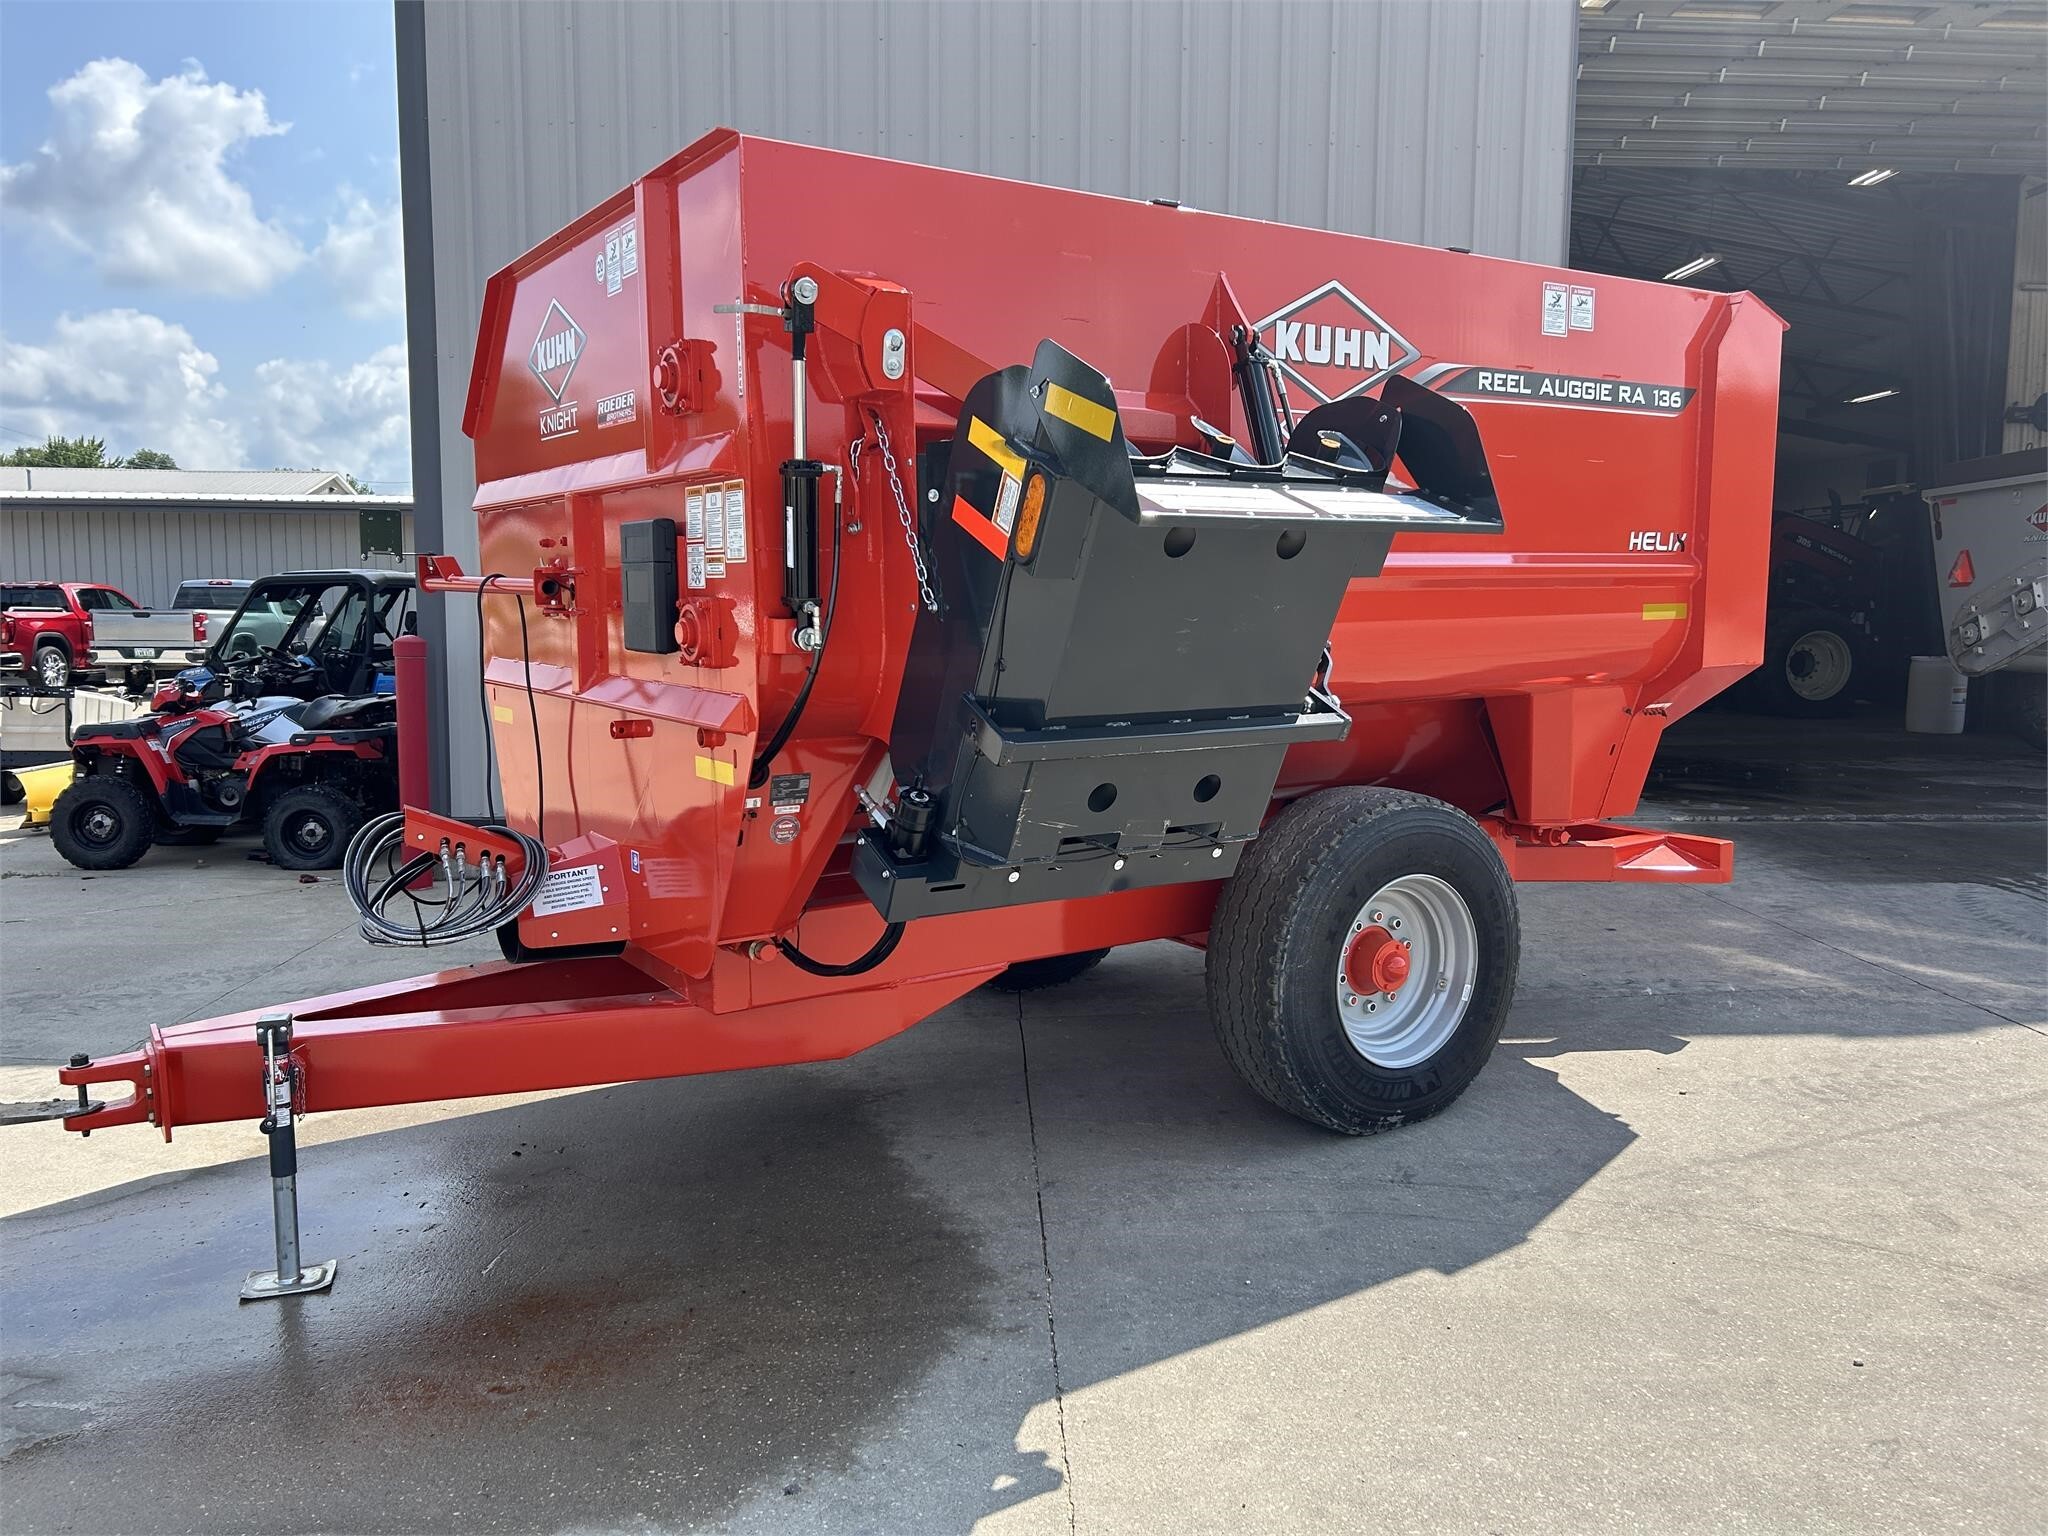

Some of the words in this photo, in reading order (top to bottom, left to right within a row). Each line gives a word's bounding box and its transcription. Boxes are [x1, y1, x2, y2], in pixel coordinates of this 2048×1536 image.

[537, 328, 576, 373] KUHN
[1275, 319, 1390, 370] KUHN
[1478, 371, 1532, 394] REEL
[1538, 377, 1613, 401] AUGGIE
[1618, 385, 1646, 405] RA
[1652, 389, 1682, 408] 136
[598, 393, 634, 415] ROEDER
[540, 407, 578, 435] KNIGHT
[1628, 531, 1687, 552] HELIX
[546, 868, 588, 881] PORTANT
